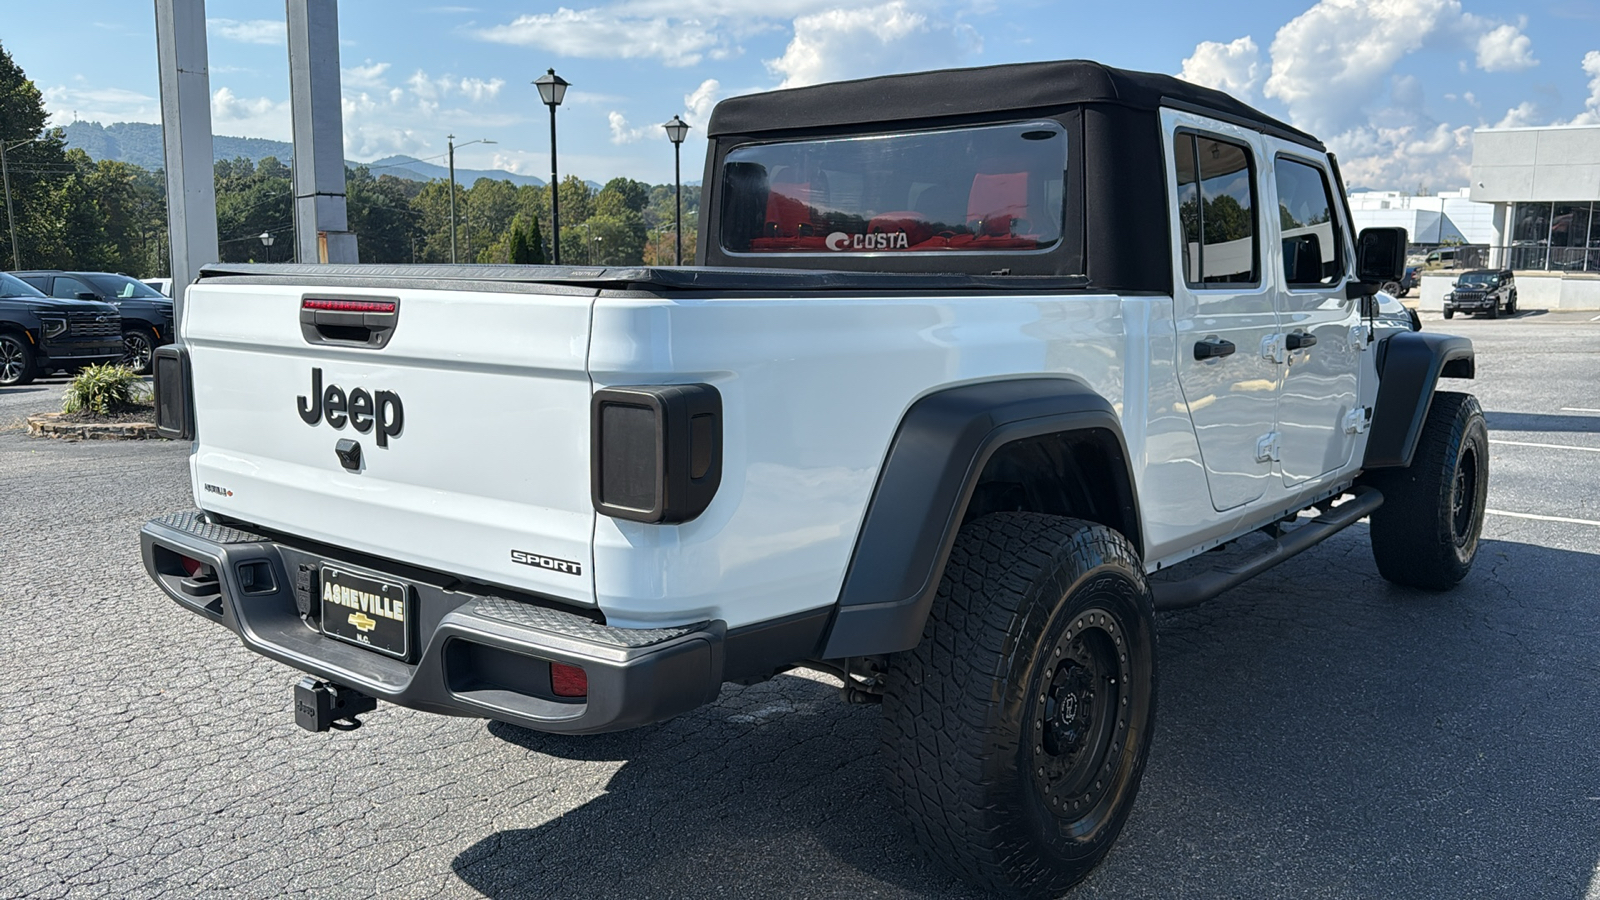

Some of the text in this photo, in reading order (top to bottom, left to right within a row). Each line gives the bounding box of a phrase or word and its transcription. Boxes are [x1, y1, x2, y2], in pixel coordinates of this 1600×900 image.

[853, 232, 909, 249] COSTA
[296, 367, 405, 449] Jeep
[512, 551, 581, 574] SPORT
[323, 581, 404, 622] ASHEVILLE
[356, 633, 371, 645] N.C.
